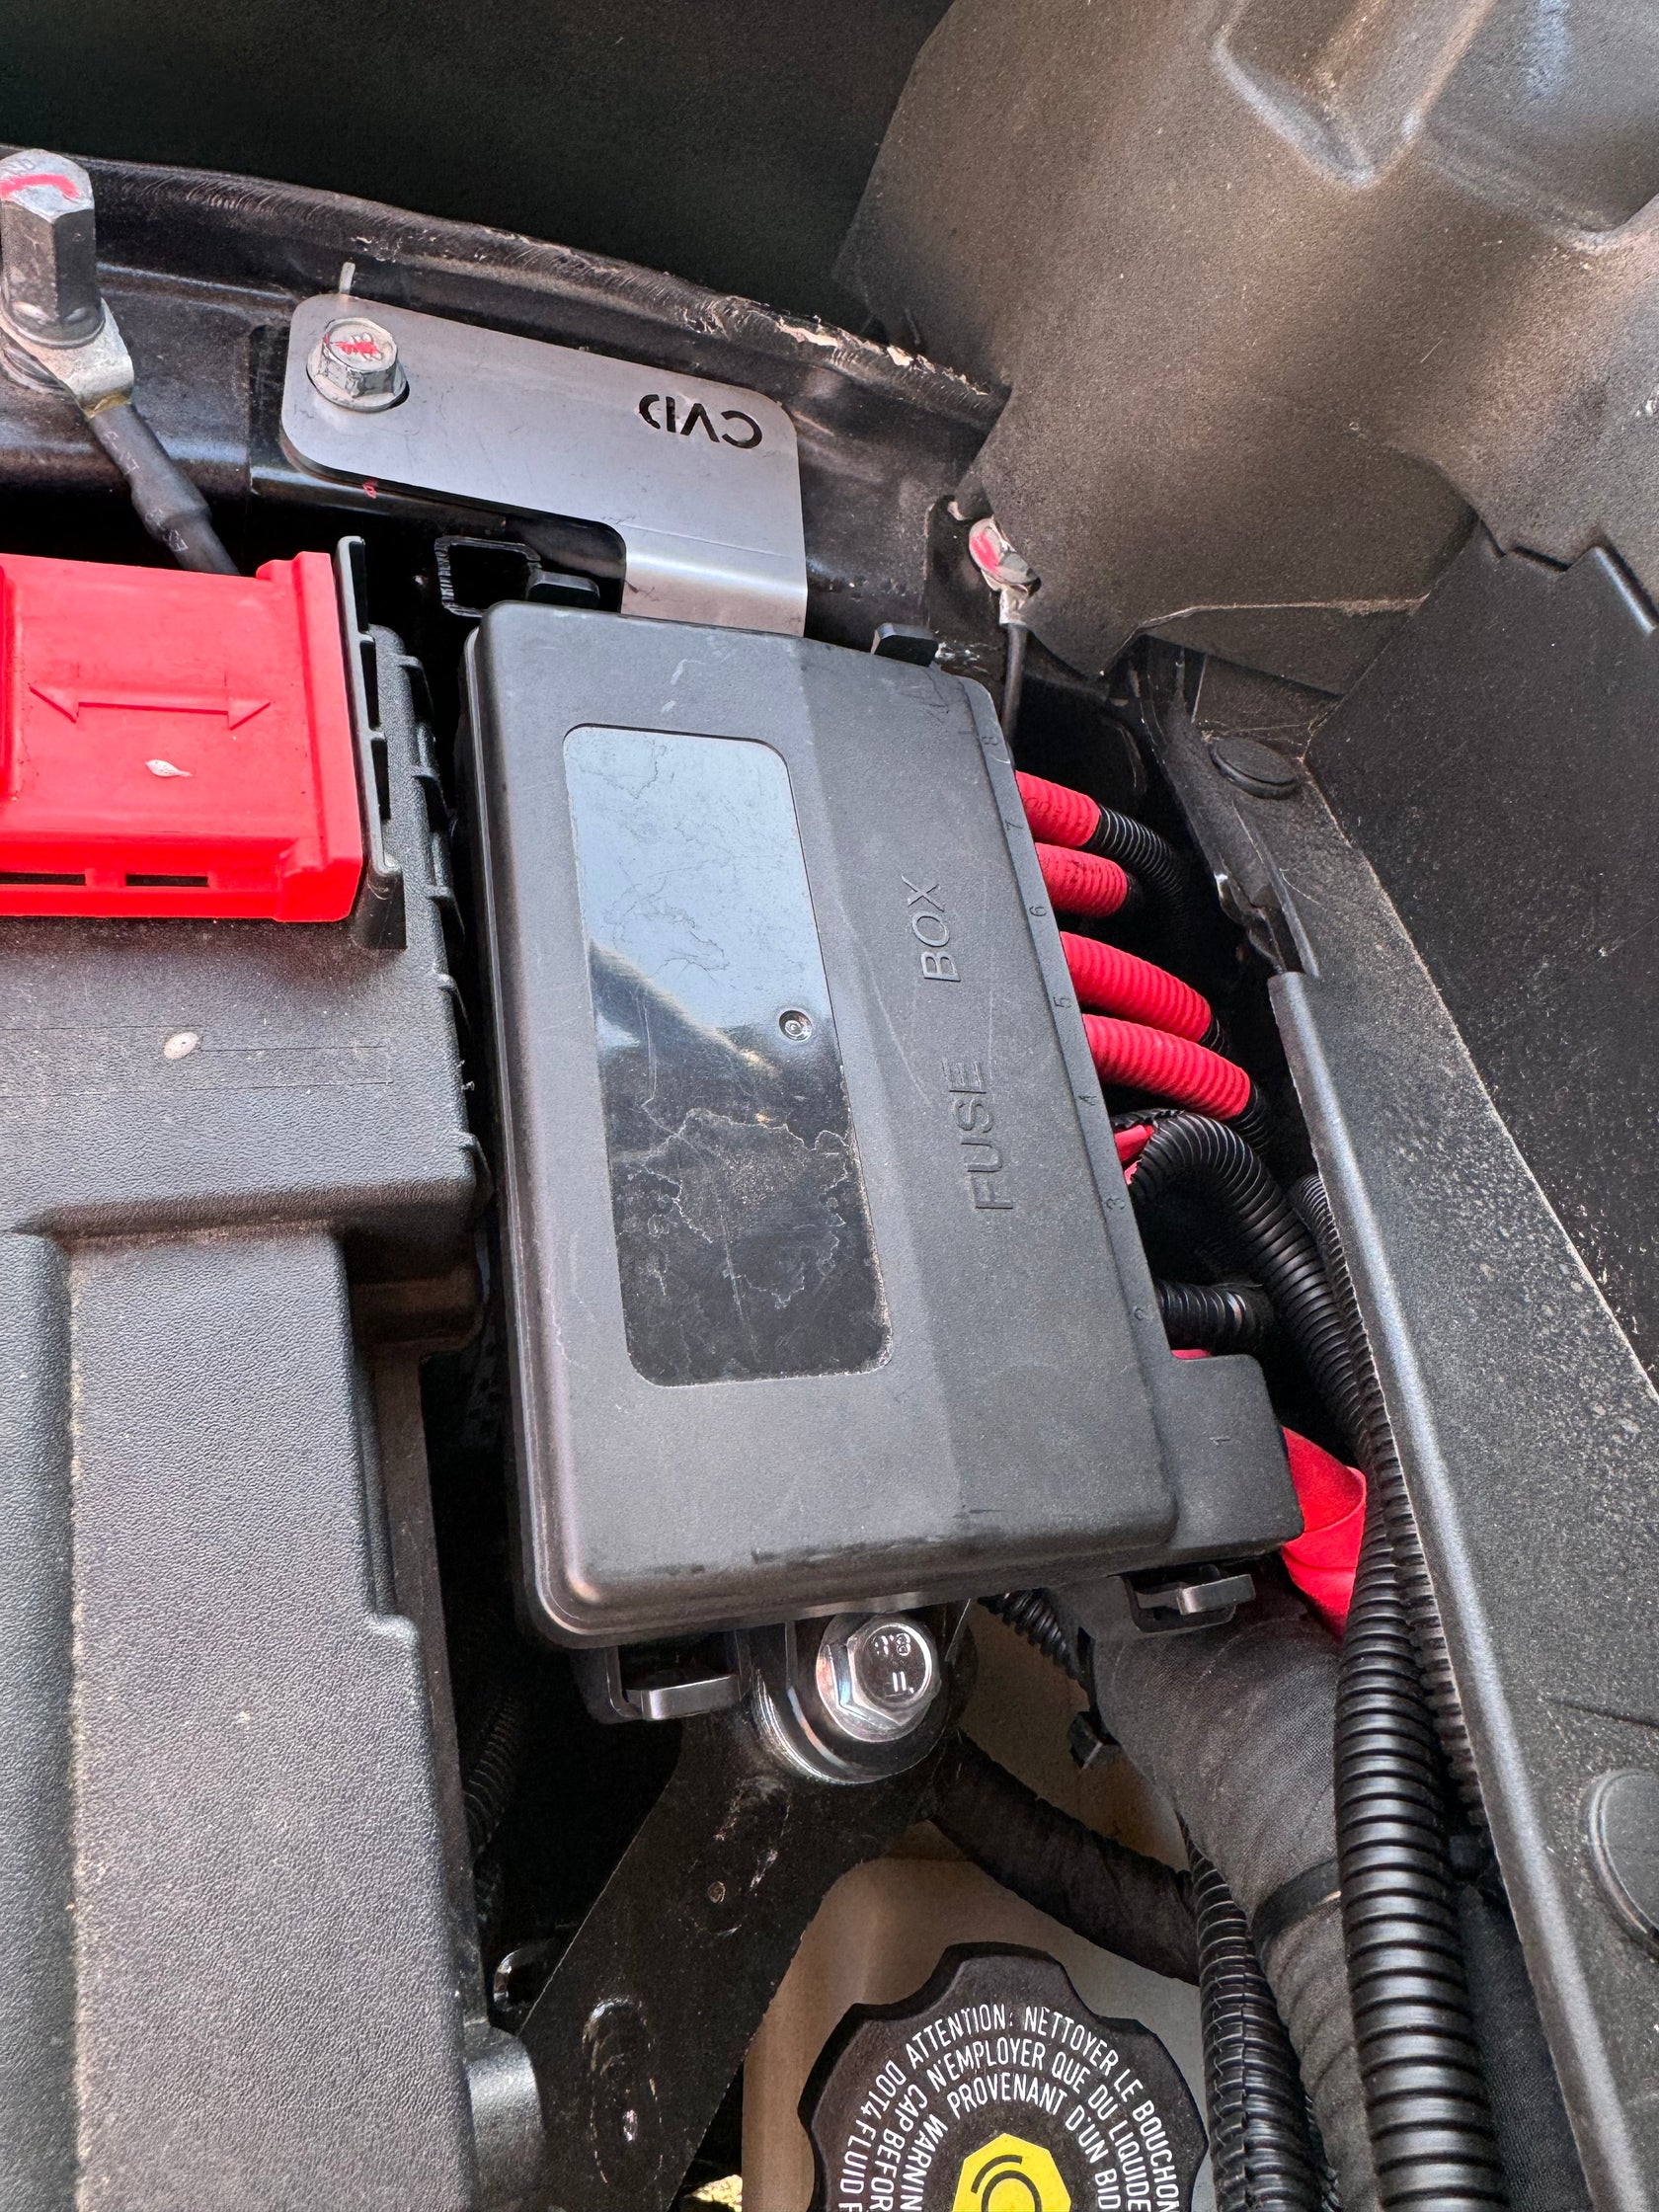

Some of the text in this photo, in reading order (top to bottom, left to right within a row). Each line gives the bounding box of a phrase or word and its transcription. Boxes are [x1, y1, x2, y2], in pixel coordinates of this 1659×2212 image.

[1029, 905, 1047, 917] 6
[1053, 995, 1072, 1009] 5
[901, 874, 1014, 1210] FUSE BOX
[860, 2060, 908, 2120] DOT4
[895, 2084, 928, 2132] CAP
[906, 2003, 1180, 2212] ATTENTION: NETTOYER LE BOUCHON
[926, 2036, 1152, 2212] N'EMPLOYER QUE DU LIQUIDE
[946, 2072, 1068, 2120] PROVENANT
[1065, 2104, 1110, 2165] D'UN
[839, 2119, 877, 2194] FLUID
